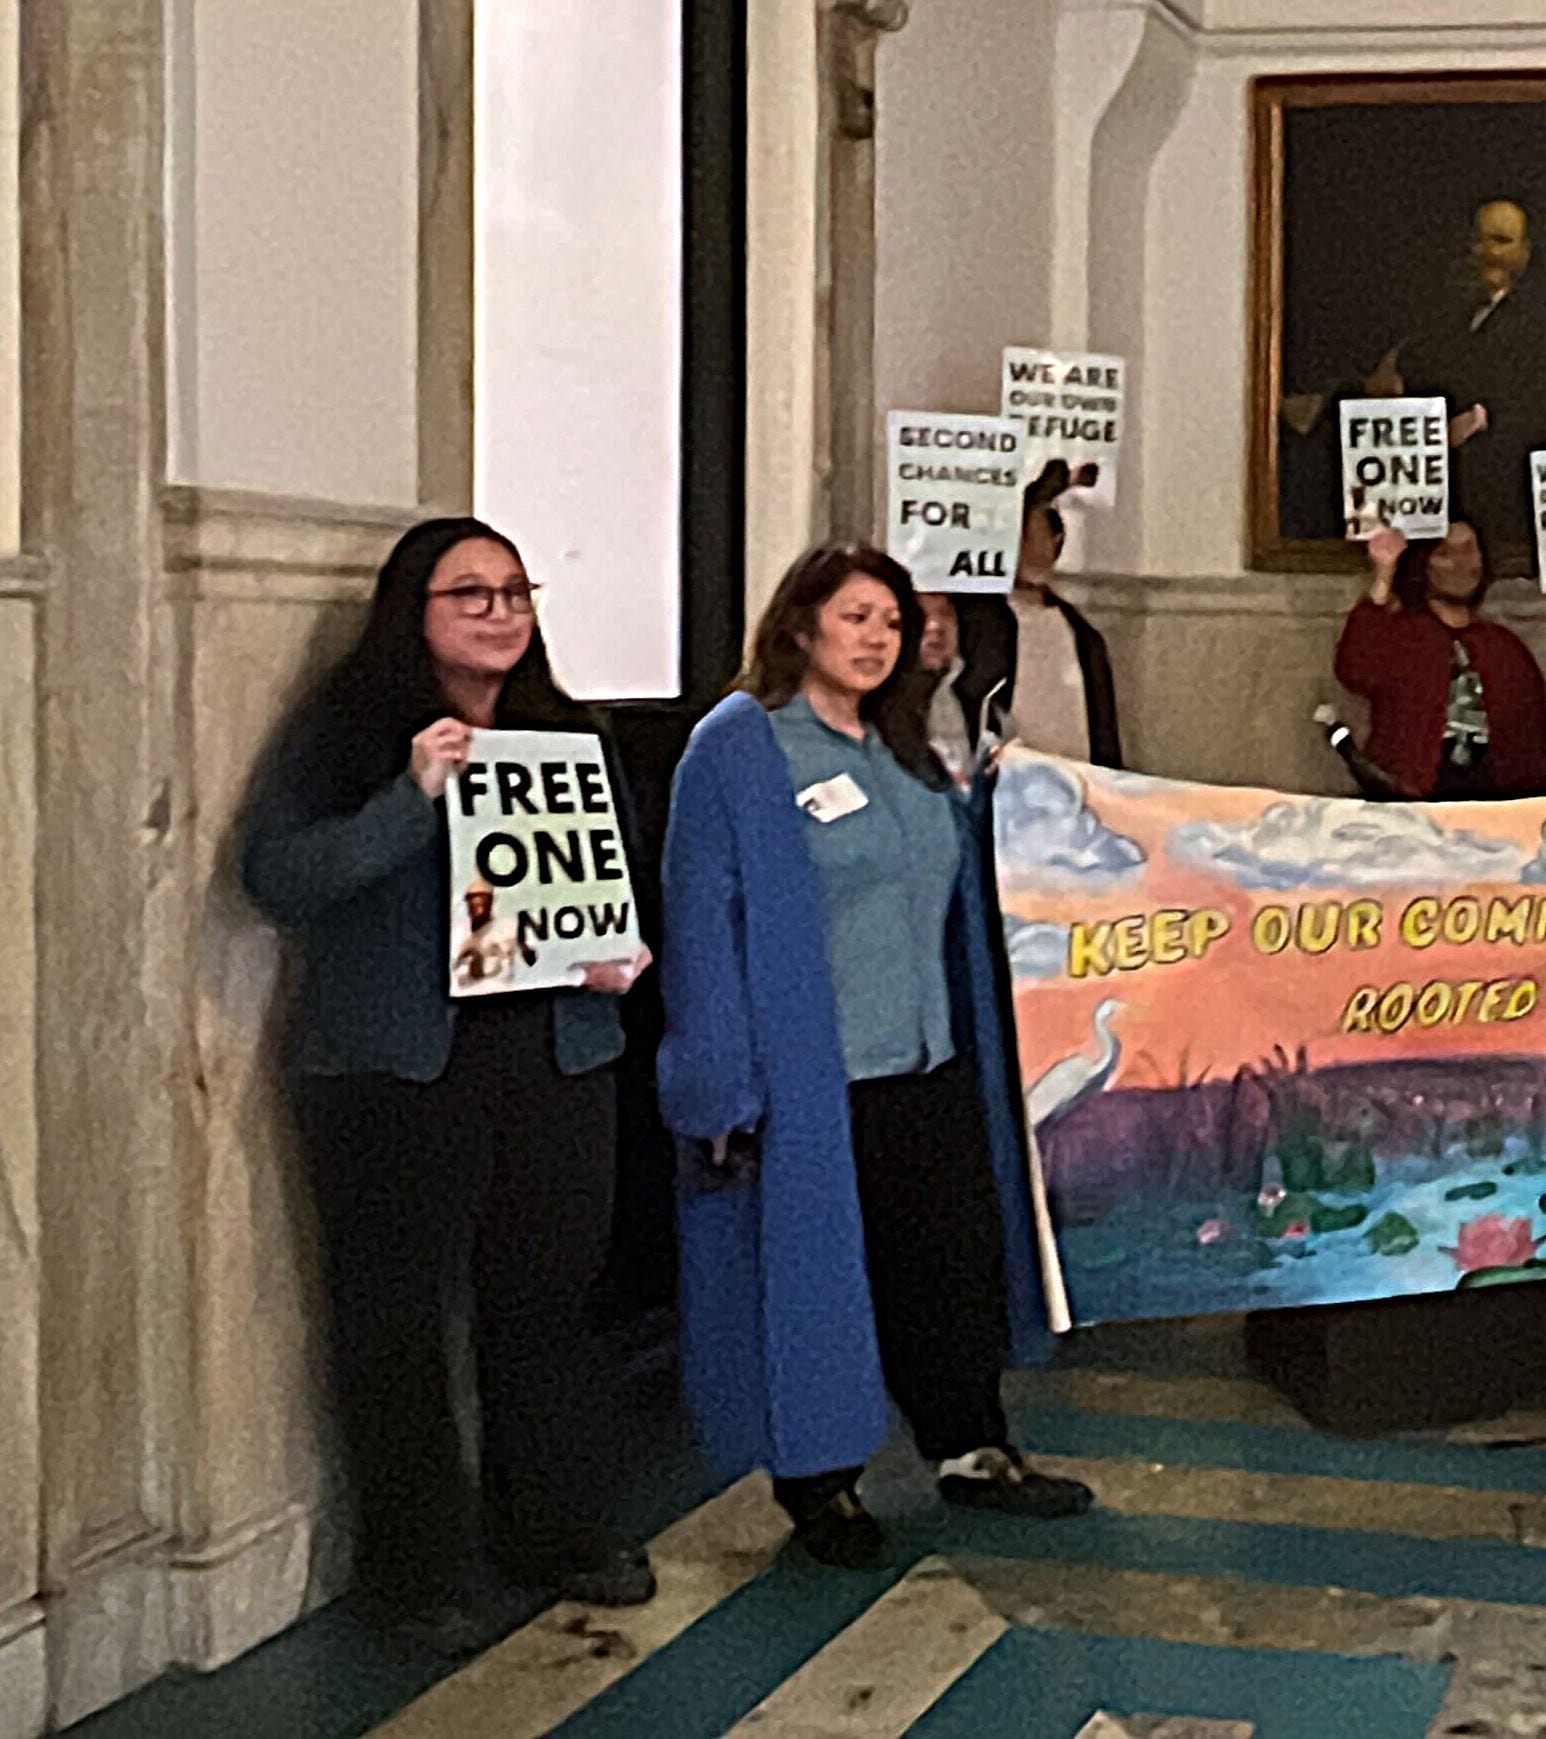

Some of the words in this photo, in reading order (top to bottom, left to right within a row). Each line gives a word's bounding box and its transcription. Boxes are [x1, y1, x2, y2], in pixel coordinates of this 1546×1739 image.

[1009, 363, 1054, 382] WE
[900, 427, 1016, 453] SECOND
[1008, 415, 1117, 442] EFUGE
[1350, 417, 1443, 448] FREE
[1356, 456, 1443, 486] ONE
[901, 500, 970, 529] FOR
[1378, 497, 1443, 518] NOW
[949, 551, 1005, 576] ALL
[459, 762, 609, 816] FREE
[476, 829, 623, 887] ONE
[517, 902, 629, 943] NOW
[1068, 907, 1231, 979] KEEP
[1252, 897, 1383, 954] OUR
[1340, 974, 1540, 1036] ROOTED
